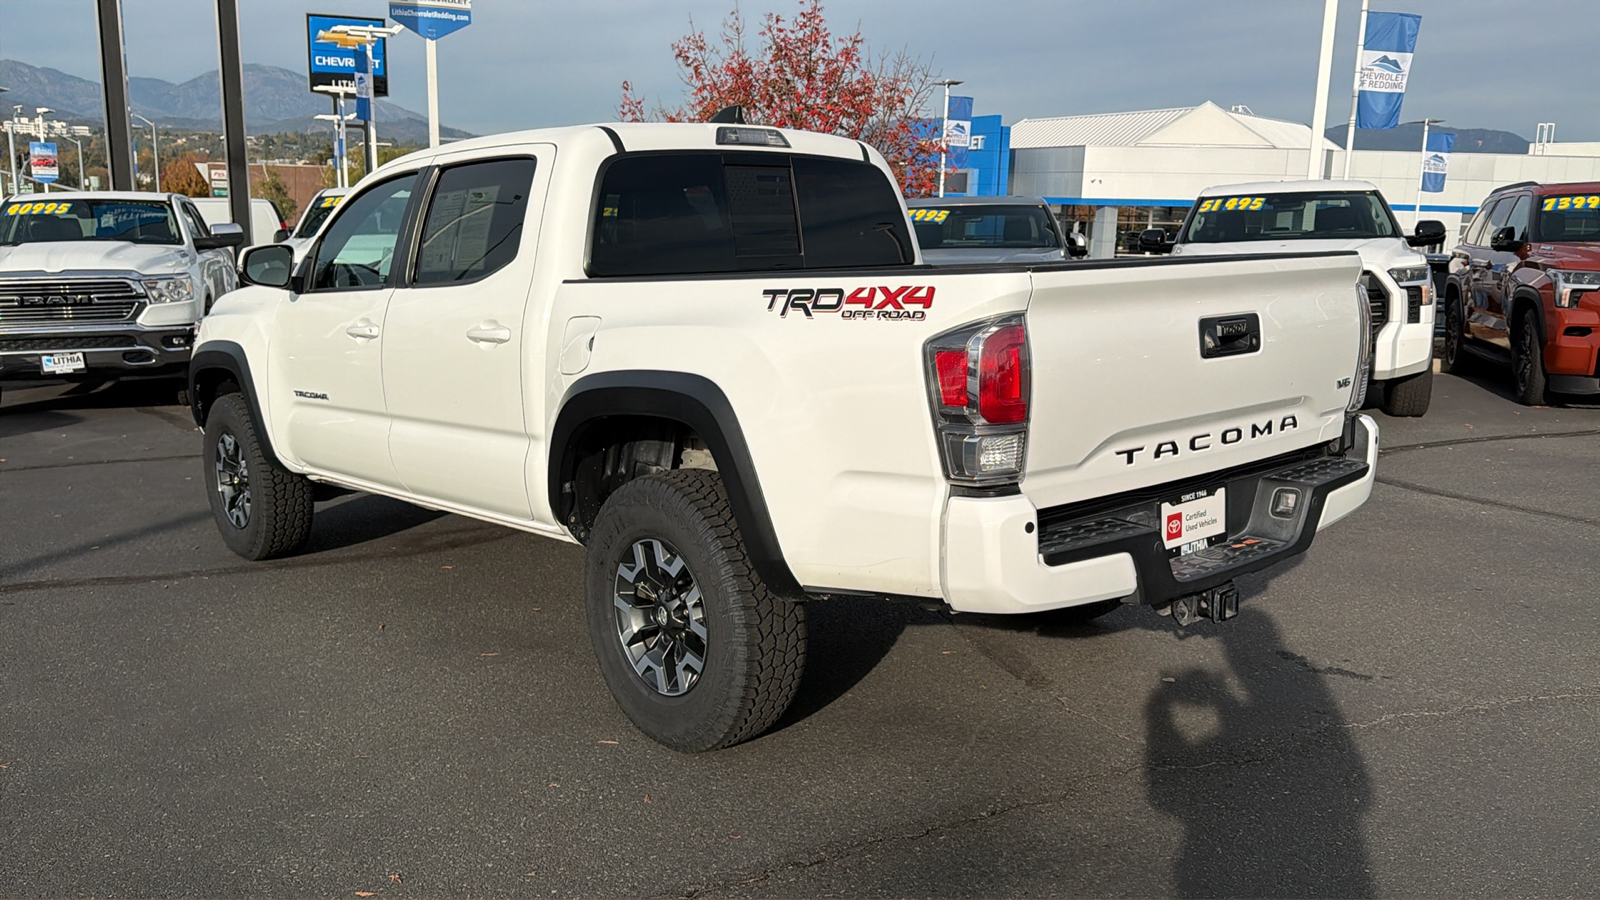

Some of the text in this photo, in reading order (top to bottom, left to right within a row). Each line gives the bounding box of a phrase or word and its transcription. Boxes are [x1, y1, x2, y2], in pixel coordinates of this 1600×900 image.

[391, 8, 469, 21] LithiaChevroletRedding.com
[315, 55, 381, 69] CHEVRT
[1368, 80, 1404, 90] REDDING
[7, 202, 71, 216] 40995
[1543, 196, 1600, 211] 7399
[23, 295, 90, 305] RAM
[762, 288, 845, 318] TRD
[841, 310, 926, 322] OFF ROAD
[53, 355, 82, 365] LITHIA
[1337, 377, 1351, 389] V6
[293, 390, 329, 401] TACOMA
[1115, 415, 1298, 466] TACOMA
[1181, 492, 1195, 502] SINCE
[1185, 508, 1207, 521] Certified
[1185, 517, 1218, 532] Used Vehicles
